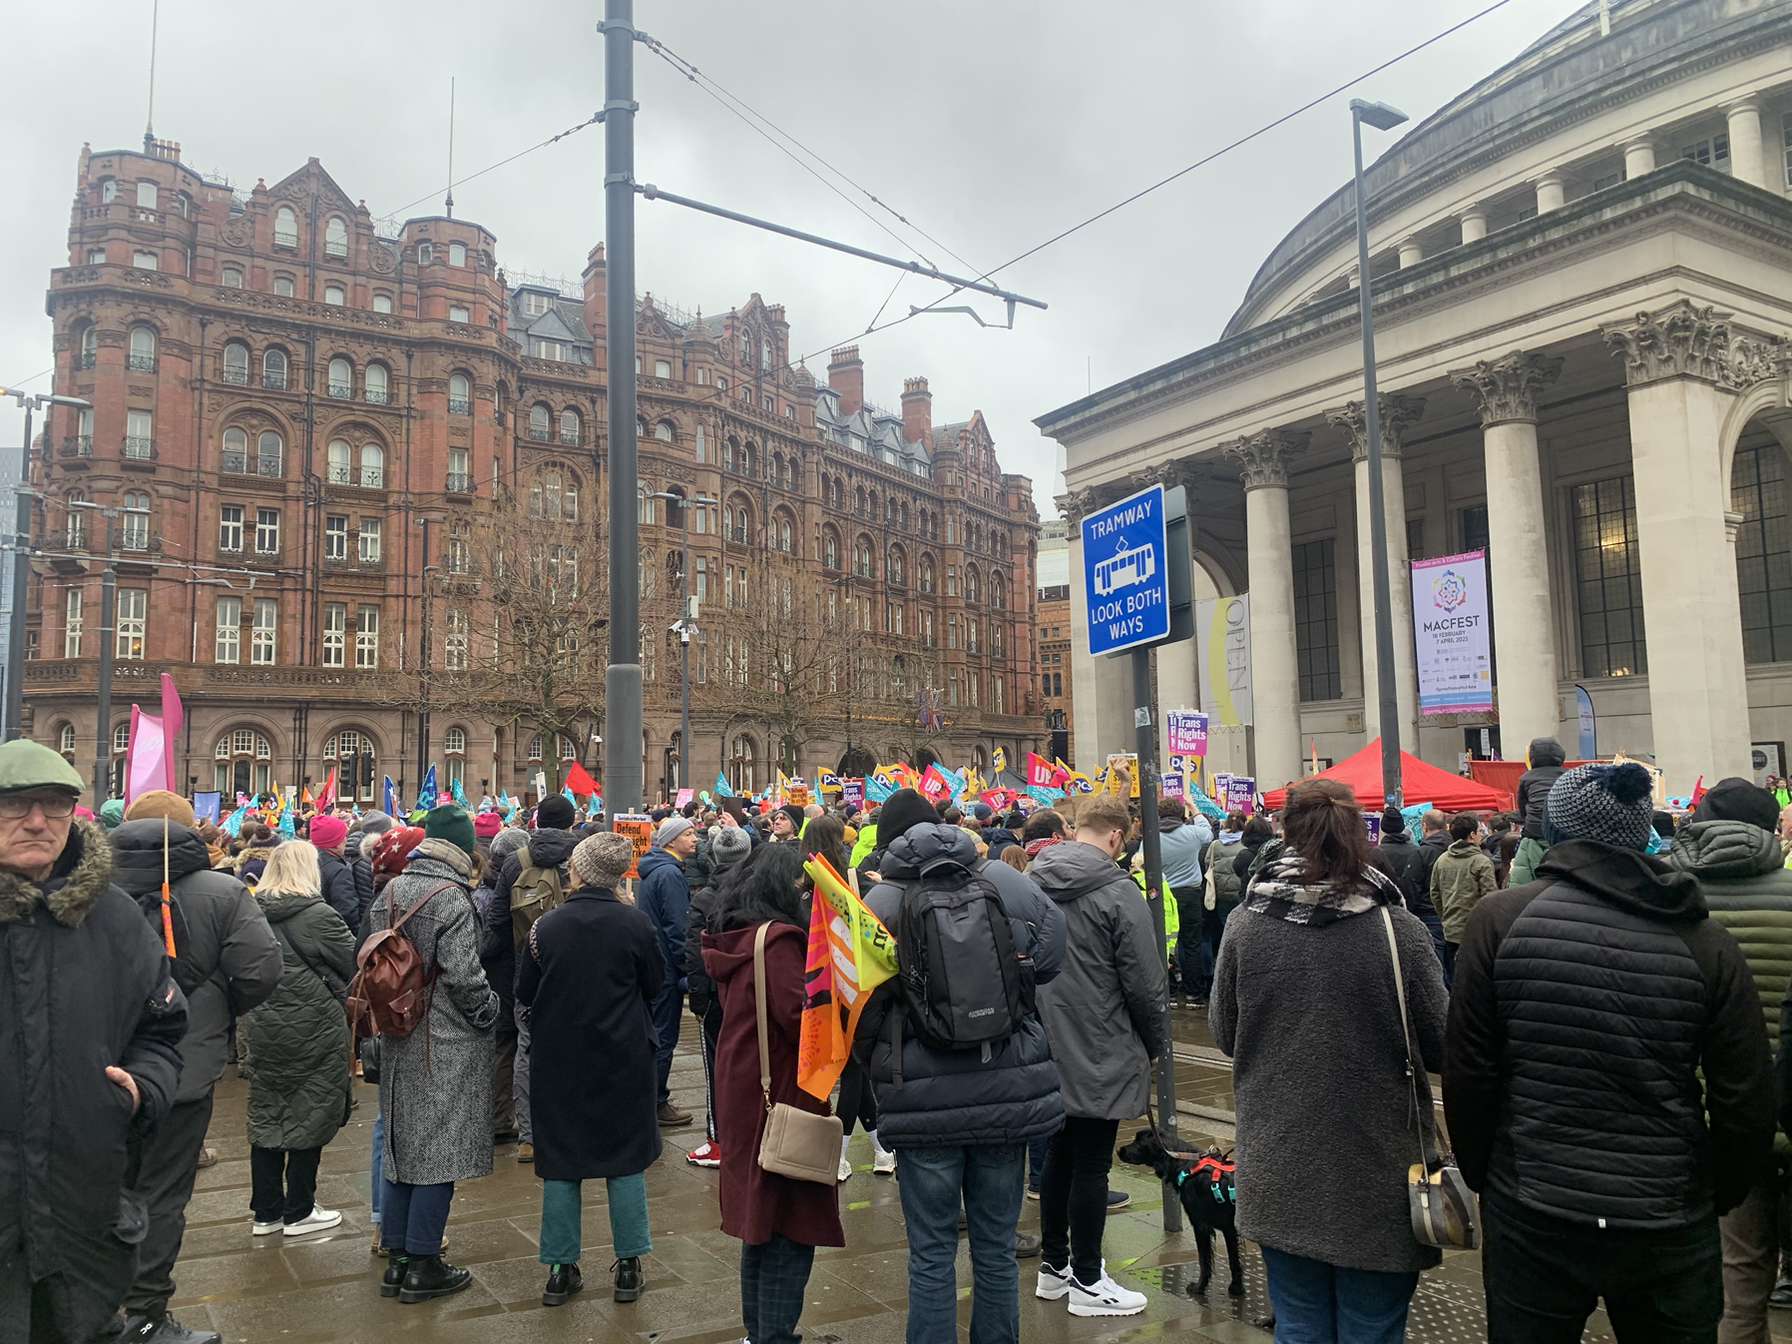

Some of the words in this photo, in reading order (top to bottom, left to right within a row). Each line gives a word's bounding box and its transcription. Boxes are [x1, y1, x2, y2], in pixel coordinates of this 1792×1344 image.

[1091, 500, 1152, 540] TRAMWAY
[1091, 600, 1123, 624] LOOK
[1127, 587, 1161, 614] BOTH
[1109, 615, 1144, 640] WAYS
[1423, 615, 1480, 632] MACFEST
[1225, 599, 1247, 692] OPEN
[1177, 716, 1201, 728] Trans
[1178, 727, 1206, 741] Rights
[1177, 739, 1197, 750] Now
[924, 777, 942, 795] UP
[1229, 780, 1248, 791] Trans
[1228, 790, 1252, 802] Rights
[616, 823, 641, 835] Defend
